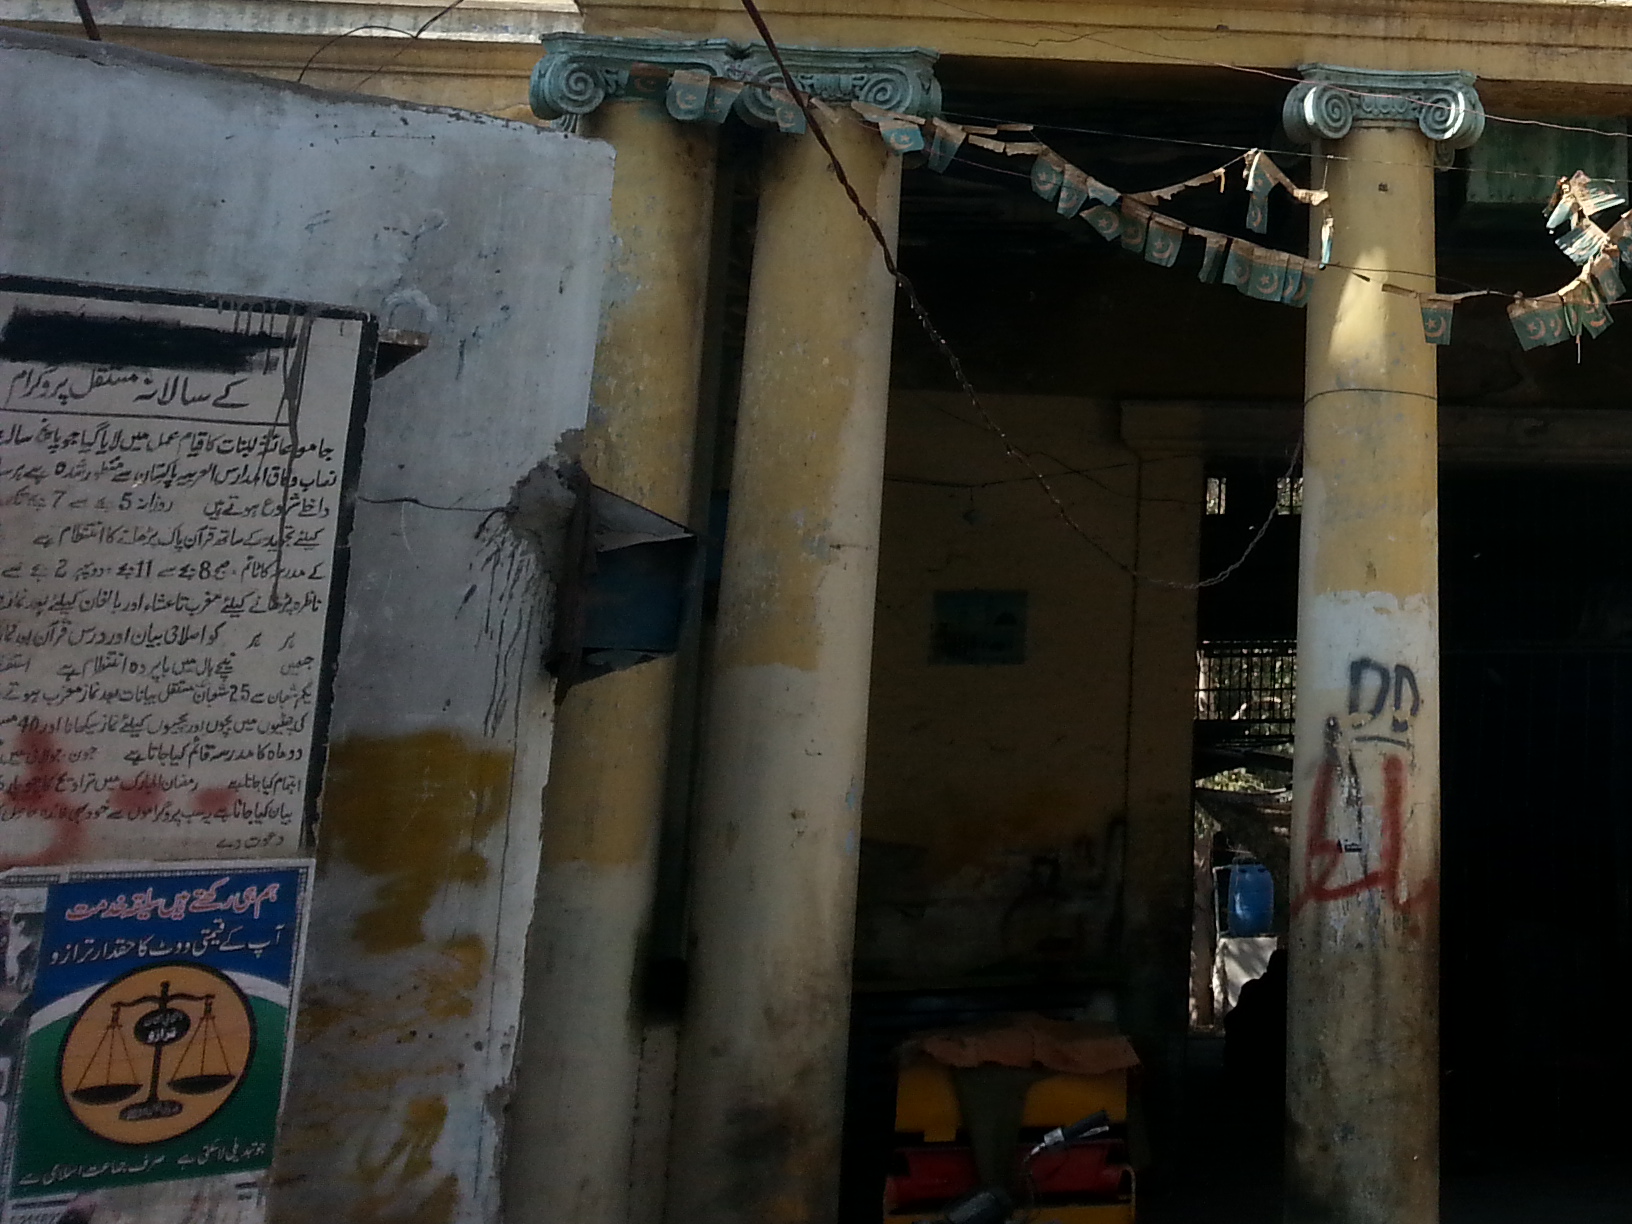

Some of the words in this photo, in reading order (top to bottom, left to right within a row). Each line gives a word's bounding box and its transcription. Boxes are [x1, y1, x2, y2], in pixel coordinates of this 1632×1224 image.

[52, 490, 67, 508] 7
[118, 491, 132, 511] 5
[54, 559, 67, 578] 2
[135, 560, 153, 579] 11
[199, 561, 211, 580] 8
[229, 684, 250, 702] 25
